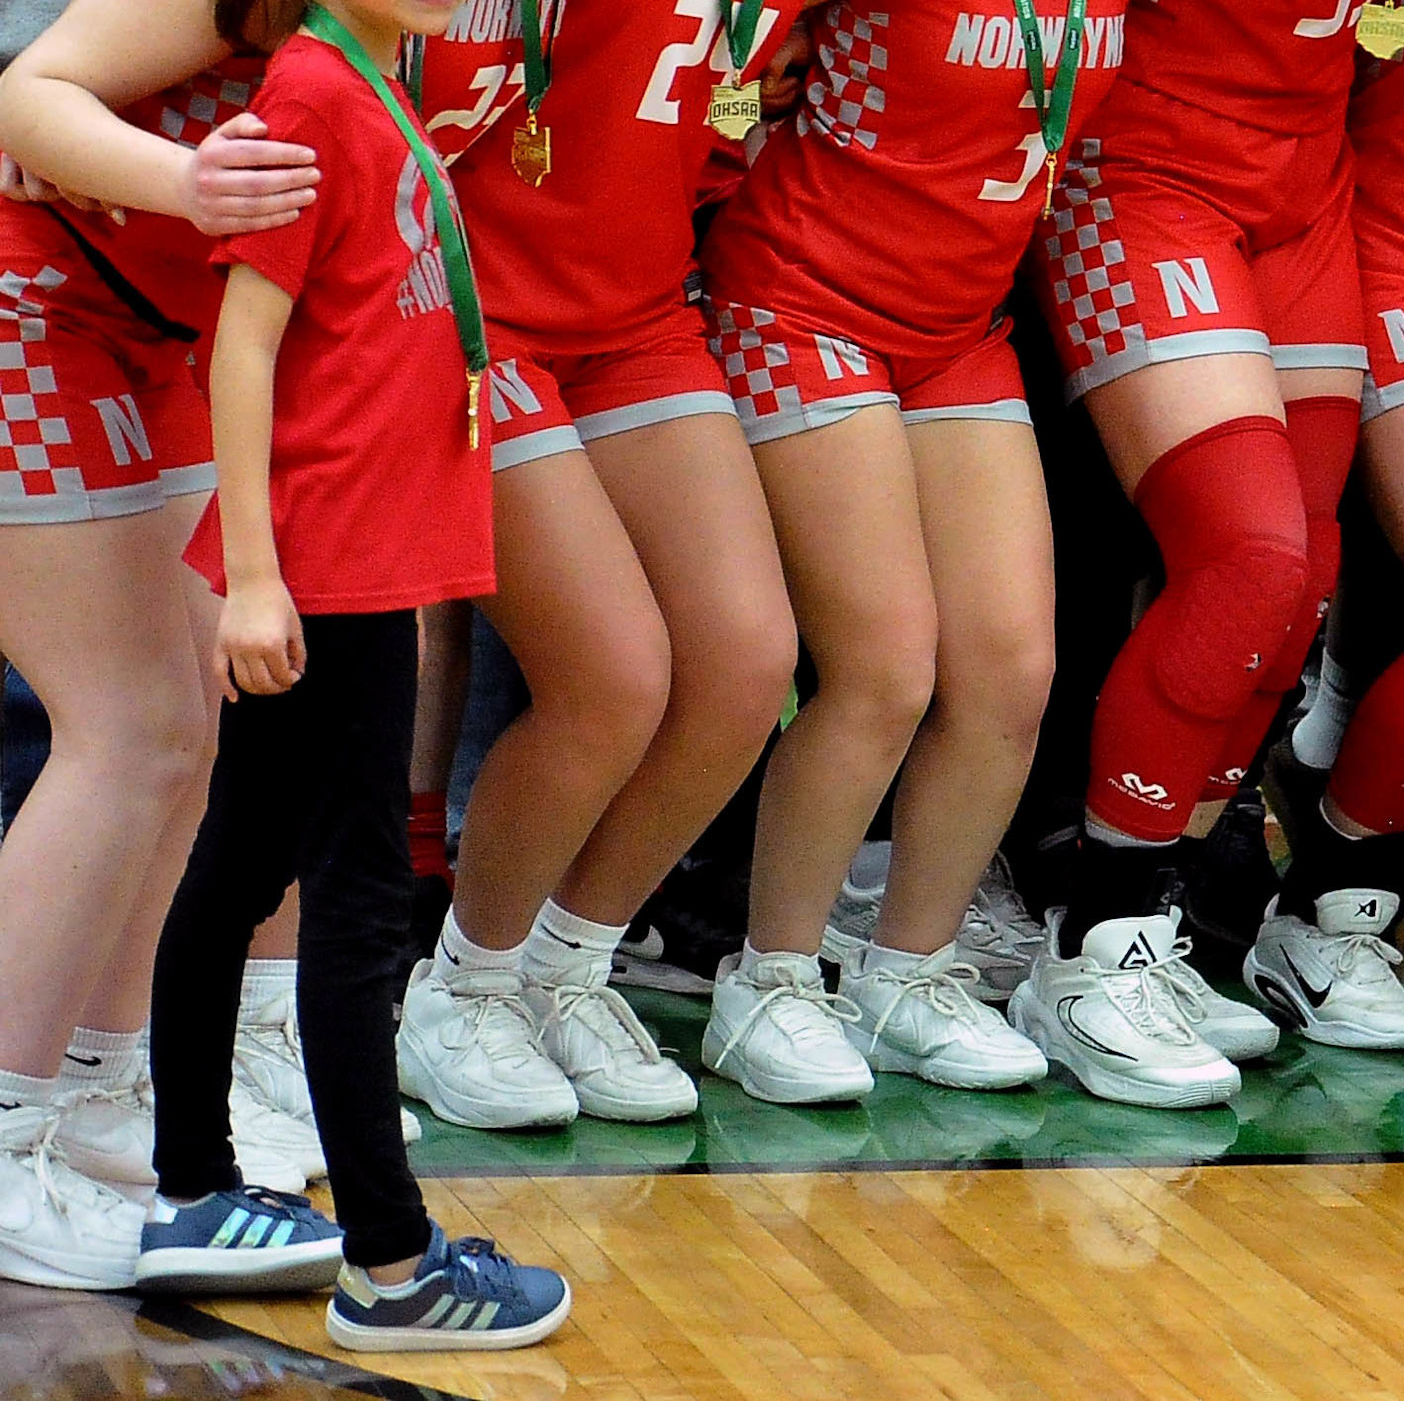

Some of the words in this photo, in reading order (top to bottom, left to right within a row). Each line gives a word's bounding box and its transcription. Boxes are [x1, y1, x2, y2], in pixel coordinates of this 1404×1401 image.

[712, 101, 759, 118] OHSAA
[1151, 257, 1220, 318] N
[90, 393, 152, 467] N
